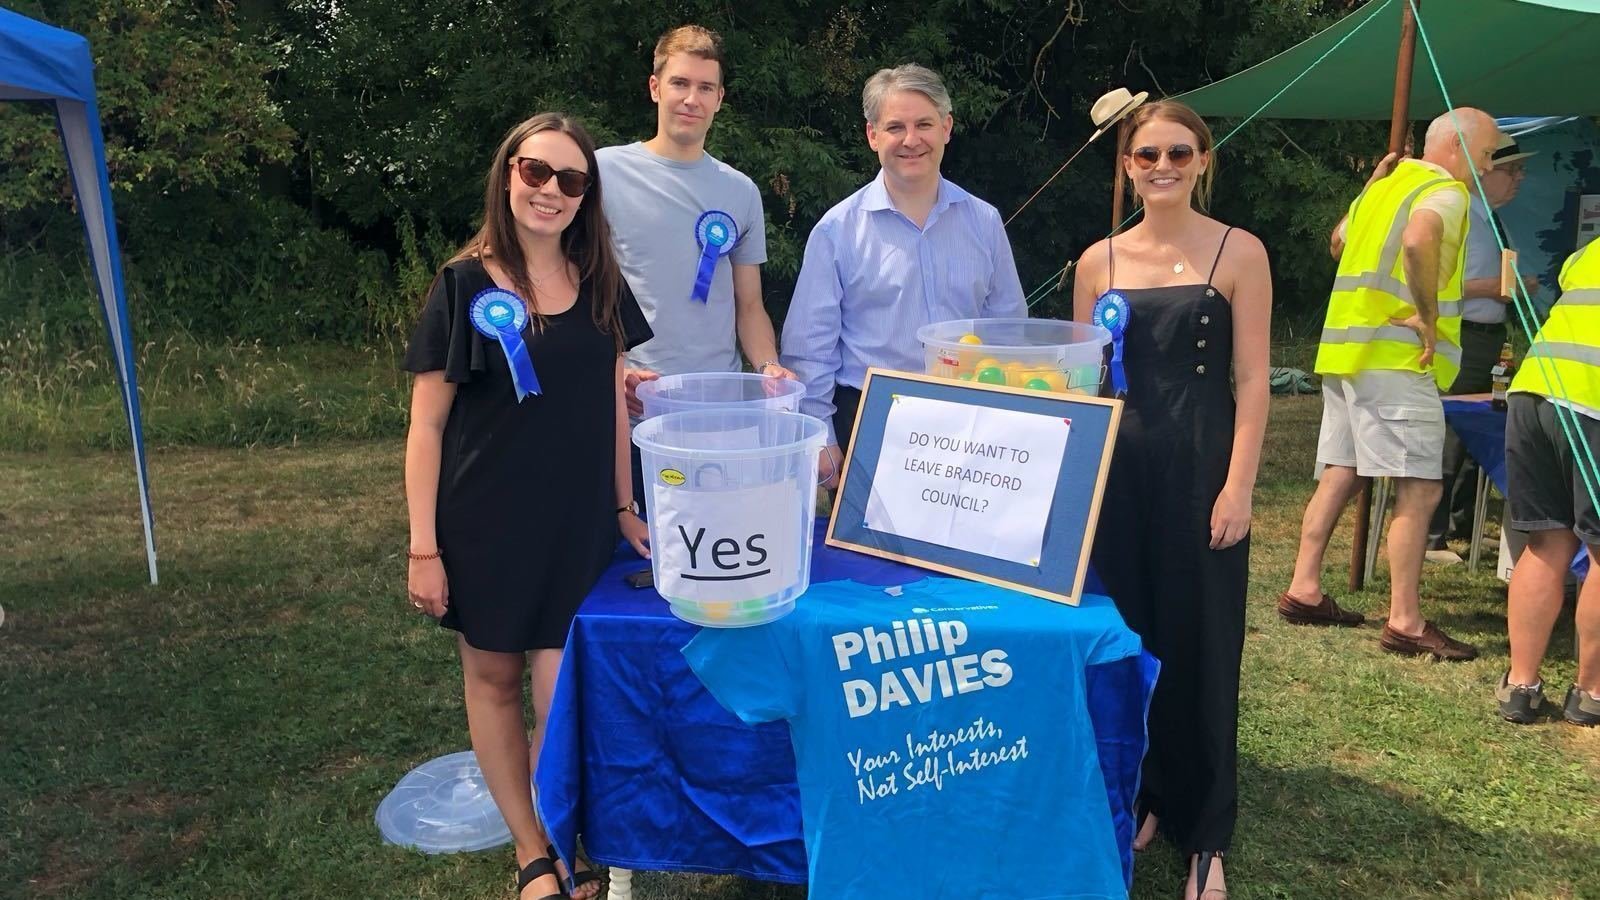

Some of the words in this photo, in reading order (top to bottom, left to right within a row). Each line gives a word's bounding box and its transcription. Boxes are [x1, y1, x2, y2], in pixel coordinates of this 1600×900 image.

[908, 432, 930, 447] DO
[933, 435, 961, 452] YOU
[963, 440, 1007, 460] WANT
[1010, 448, 1030, 464] TO
[904, 458, 942, 477] LEAVE
[945, 465, 1022, 491] BRADFORD
[921, 488, 989, 513] COUNCIL?
[678, 525, 768, 570] Yes
[930, 605, 999, 613] Conservatives
[831, 618, 968, 671] Philip
[842, 649, 1013, 719] DAVIES
[847, 748, 901, 776] Your
[906, 716, 1003, 759] Interests,
[857, 772, 899, 805] Not
[903, 735, 1029, 791] Self-Interest
